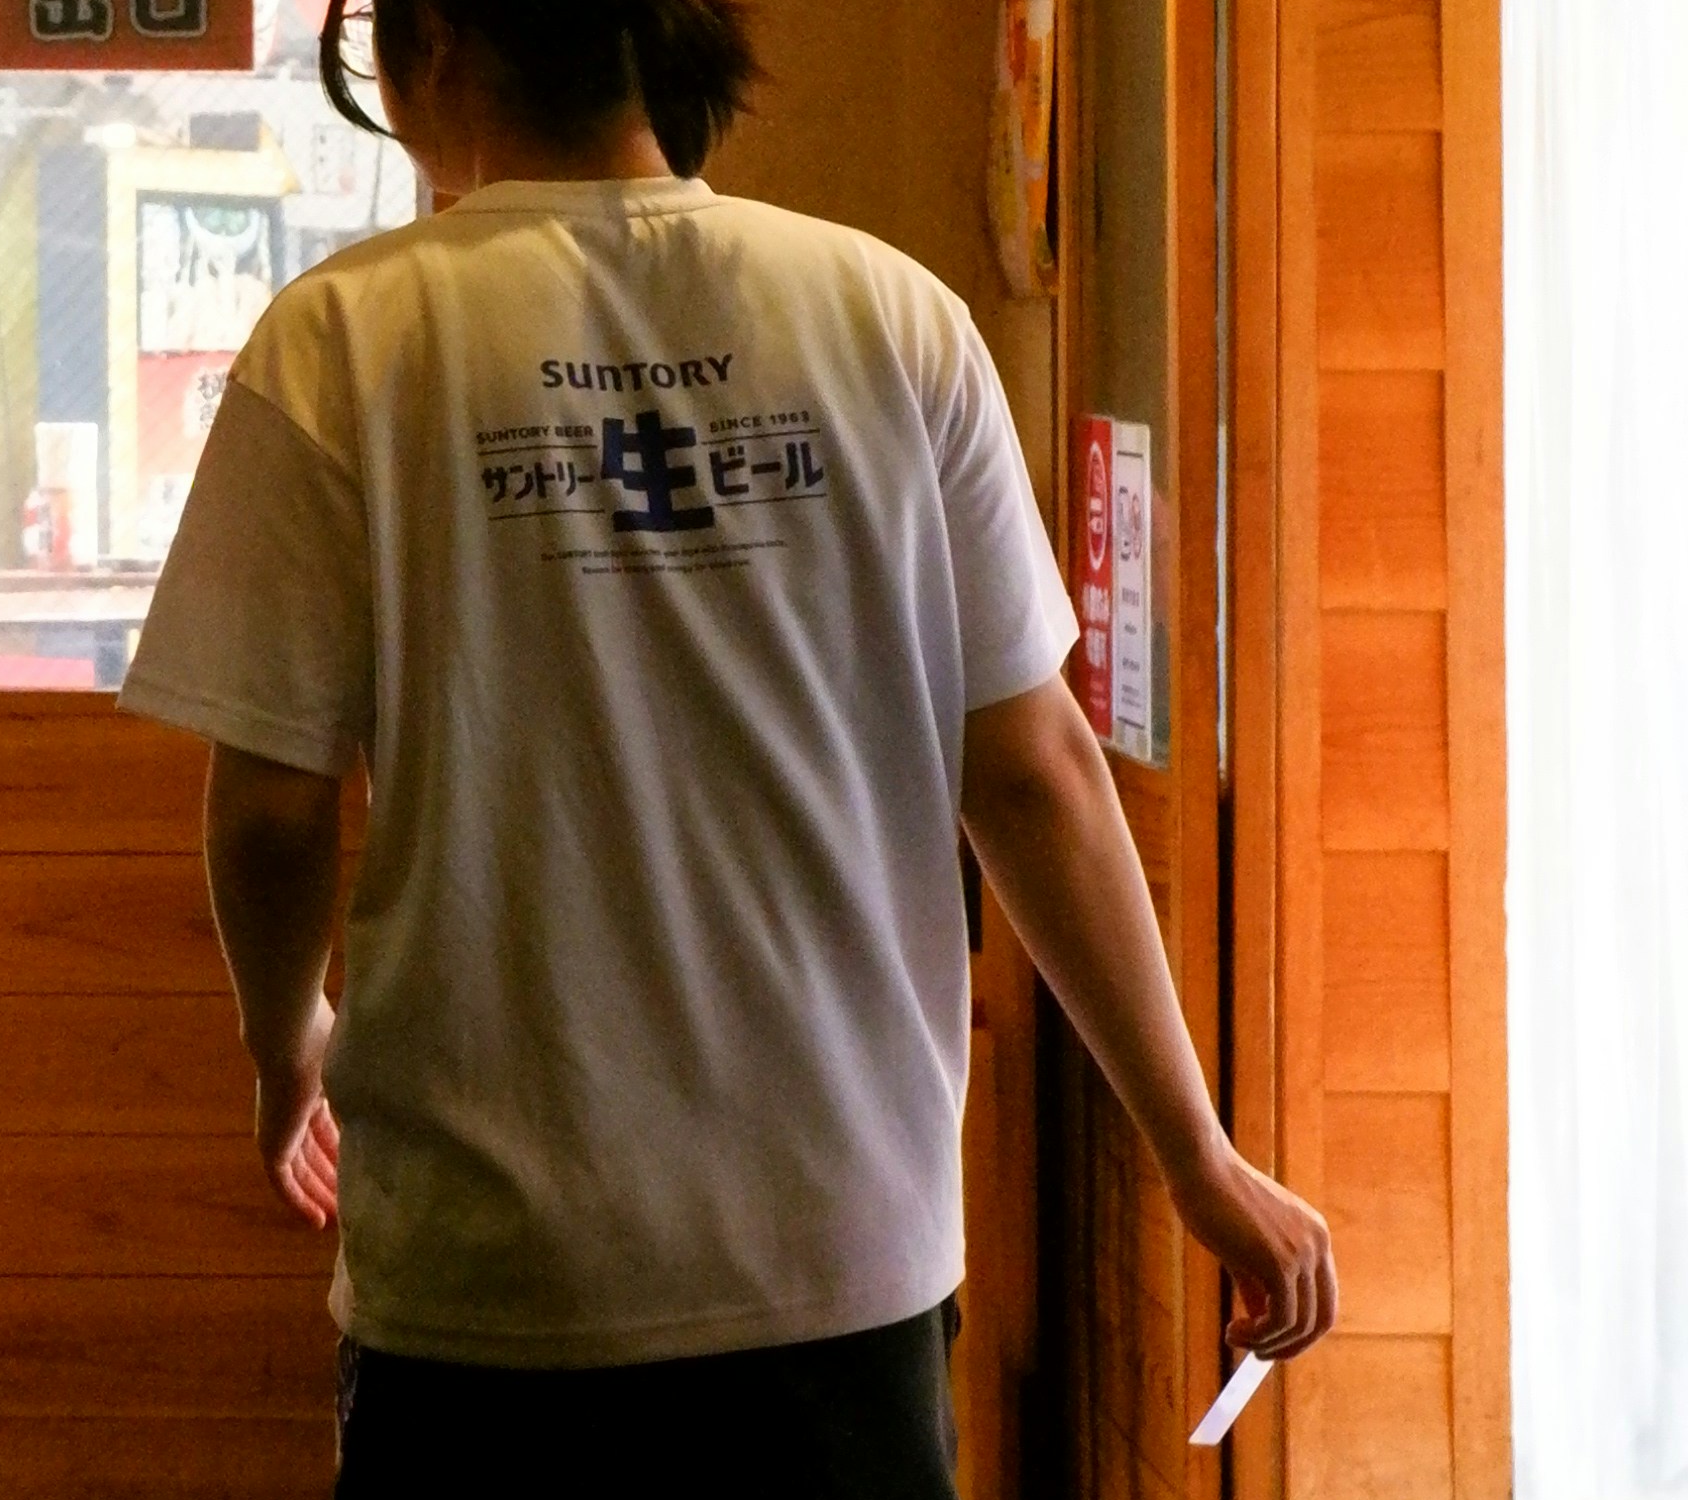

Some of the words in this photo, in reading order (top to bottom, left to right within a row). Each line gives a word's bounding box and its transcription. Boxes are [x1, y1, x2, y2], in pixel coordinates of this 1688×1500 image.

[540, 353, 733, 391] SUNTORY
[476, 425, 550, 444] SUNTORY
[554, 425, 594, 438] BEER
[709, 414, 762, 433] SINCE
[482, 461, 595, 502] サントリー
[600, 410, 715, 532] 生
[709, 441, 824, 496] ビール
